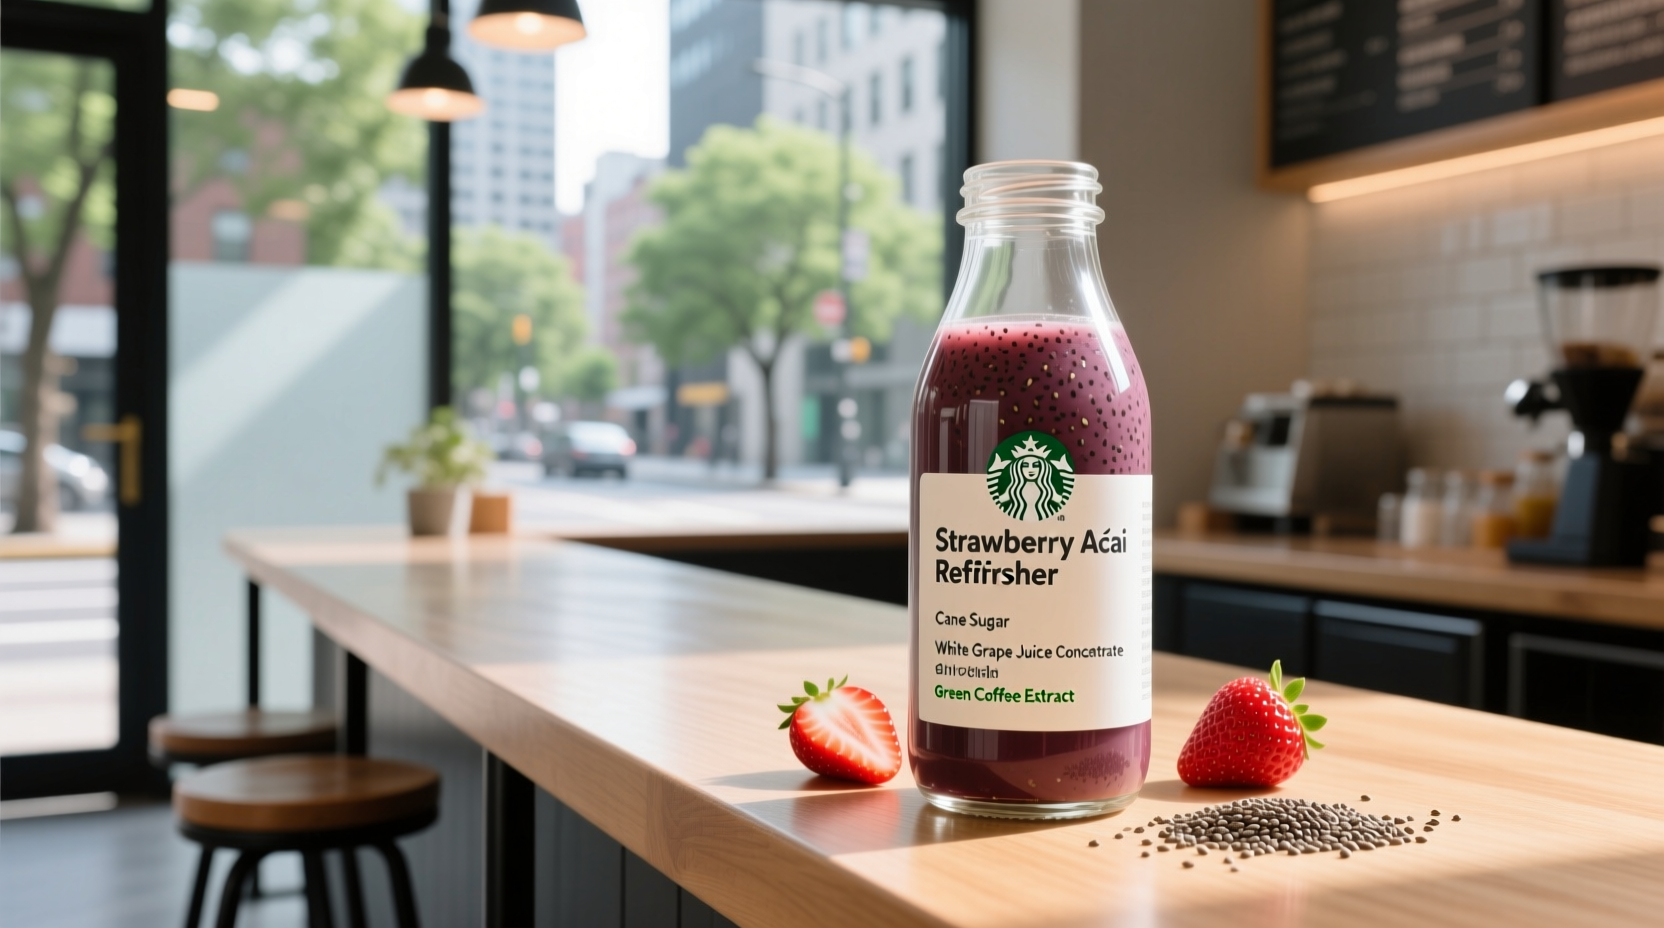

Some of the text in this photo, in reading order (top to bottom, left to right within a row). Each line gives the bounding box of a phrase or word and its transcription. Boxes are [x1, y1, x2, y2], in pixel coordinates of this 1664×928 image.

[935, 526, 1075, 561] Strawberry
[935, 610, 1011, 632] Cane Sugar
[935, 640, 969, 657] White
[971, 643, 1013, 662] Grape
[1015, 644, 1053, 659] Juice
[934, 684, 972, 701] Green
[974, 687, 1021, 703] Coffee
